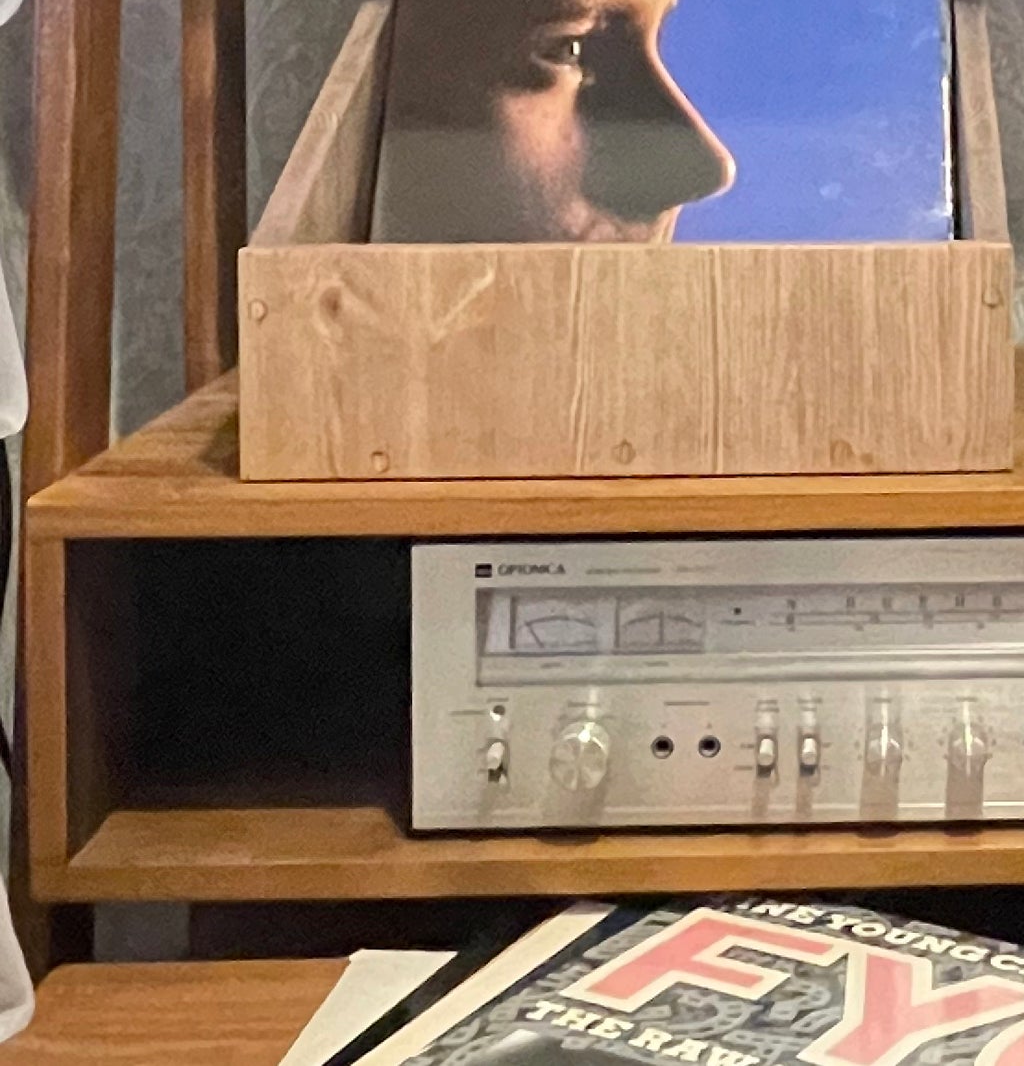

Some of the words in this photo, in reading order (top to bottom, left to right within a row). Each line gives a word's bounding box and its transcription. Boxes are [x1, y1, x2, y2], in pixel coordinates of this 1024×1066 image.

[735, 898, 825, 925] INE
[825, 913, 988, 962] YOUNG
[525, 1000, 635, 1039] THE
[628, 1028, 760, 1066] RAW
